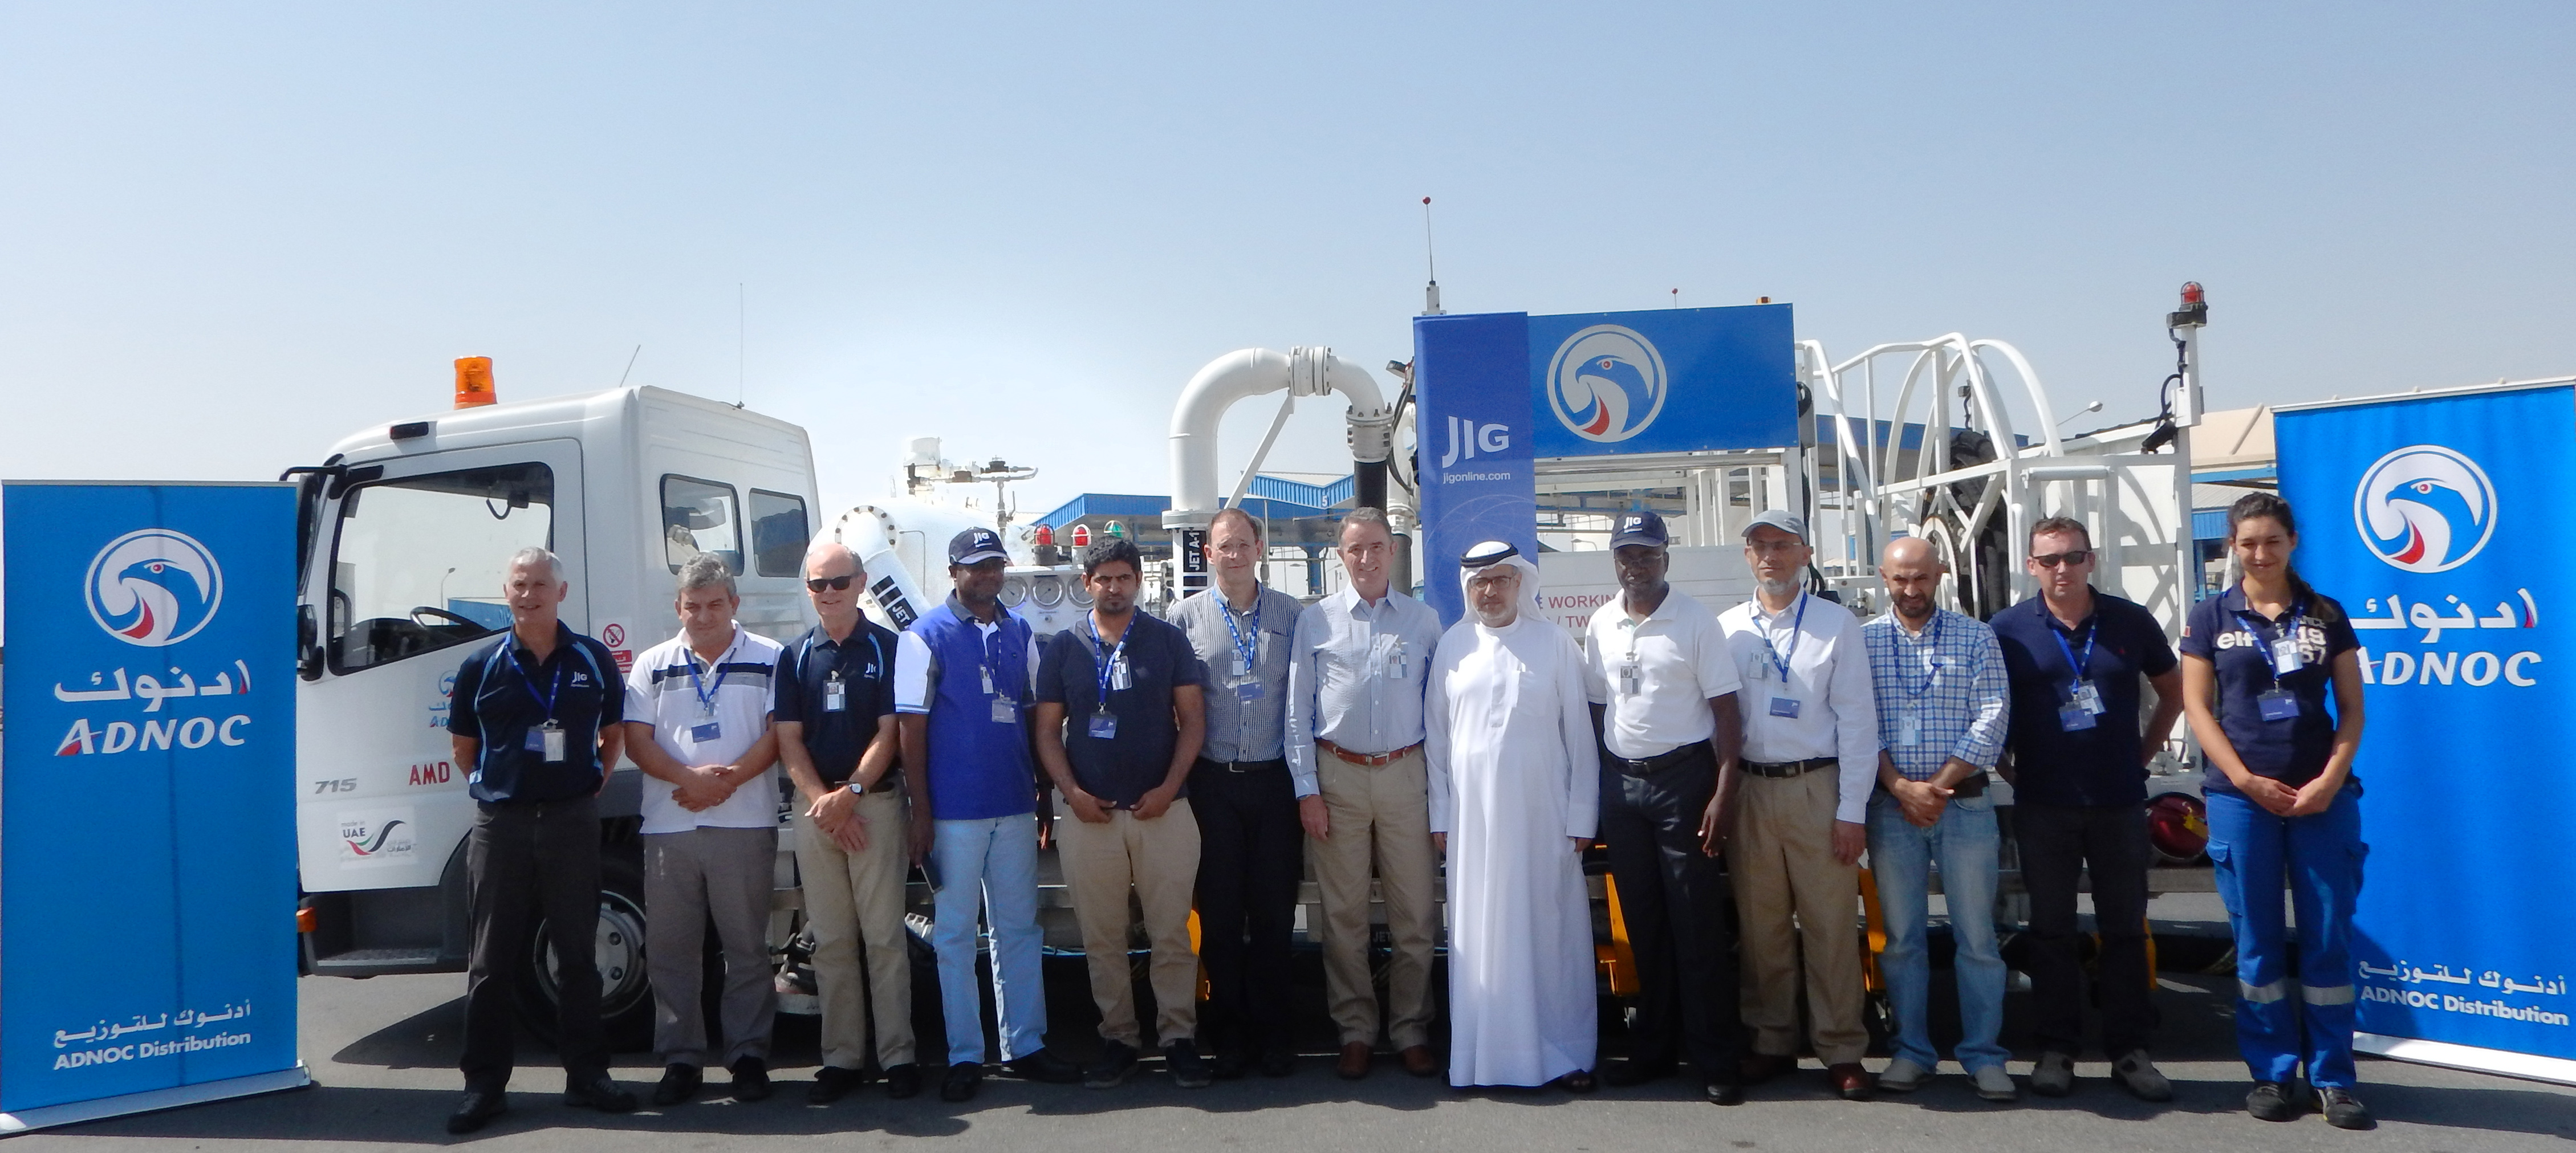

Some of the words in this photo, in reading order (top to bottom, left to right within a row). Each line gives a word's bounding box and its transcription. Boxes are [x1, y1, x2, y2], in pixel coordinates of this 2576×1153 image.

[1442, 415, 1509, 468] JIG
[1443, 471, 1511, 484] jigonline.com
[1322, 495, 1328, 507] 5
[1623, 516, 1642, 529] JIG
[973, 532, 990, 544] JIG
[1189, 532, 1200, 548] A-1
[1189, 551, 1200, 571] JET
[1548, 594, 1616, 609] WORKIN
[892, 605, 911, 623] JET
[2296, 626, 2326, 645] 19
[2356, 647, 2542, 687] ADNOC
[572, 671, 588, 683] JIG
[54, 714, 251, 756] ADNOC
[409, 761, 450, 785] AMD
[315, 778, 357, 794] 715
[343, 828, 365, 838] UAE
[2358, 959, 2472, 984] للتوزيع
[2478, 970, 2566, 995] أدنوك
[174, 999, 251, 1028] أدنوك
[2360, 985, 2439, 1010] ADNOC
[2444, 994, 2569, 1026] Distribution
[54, 1012, 168, 1049] للتوزيع
[54, 1044, 135, 1070] ADNOC
[140, 1032, 251, 1059] Distribution
